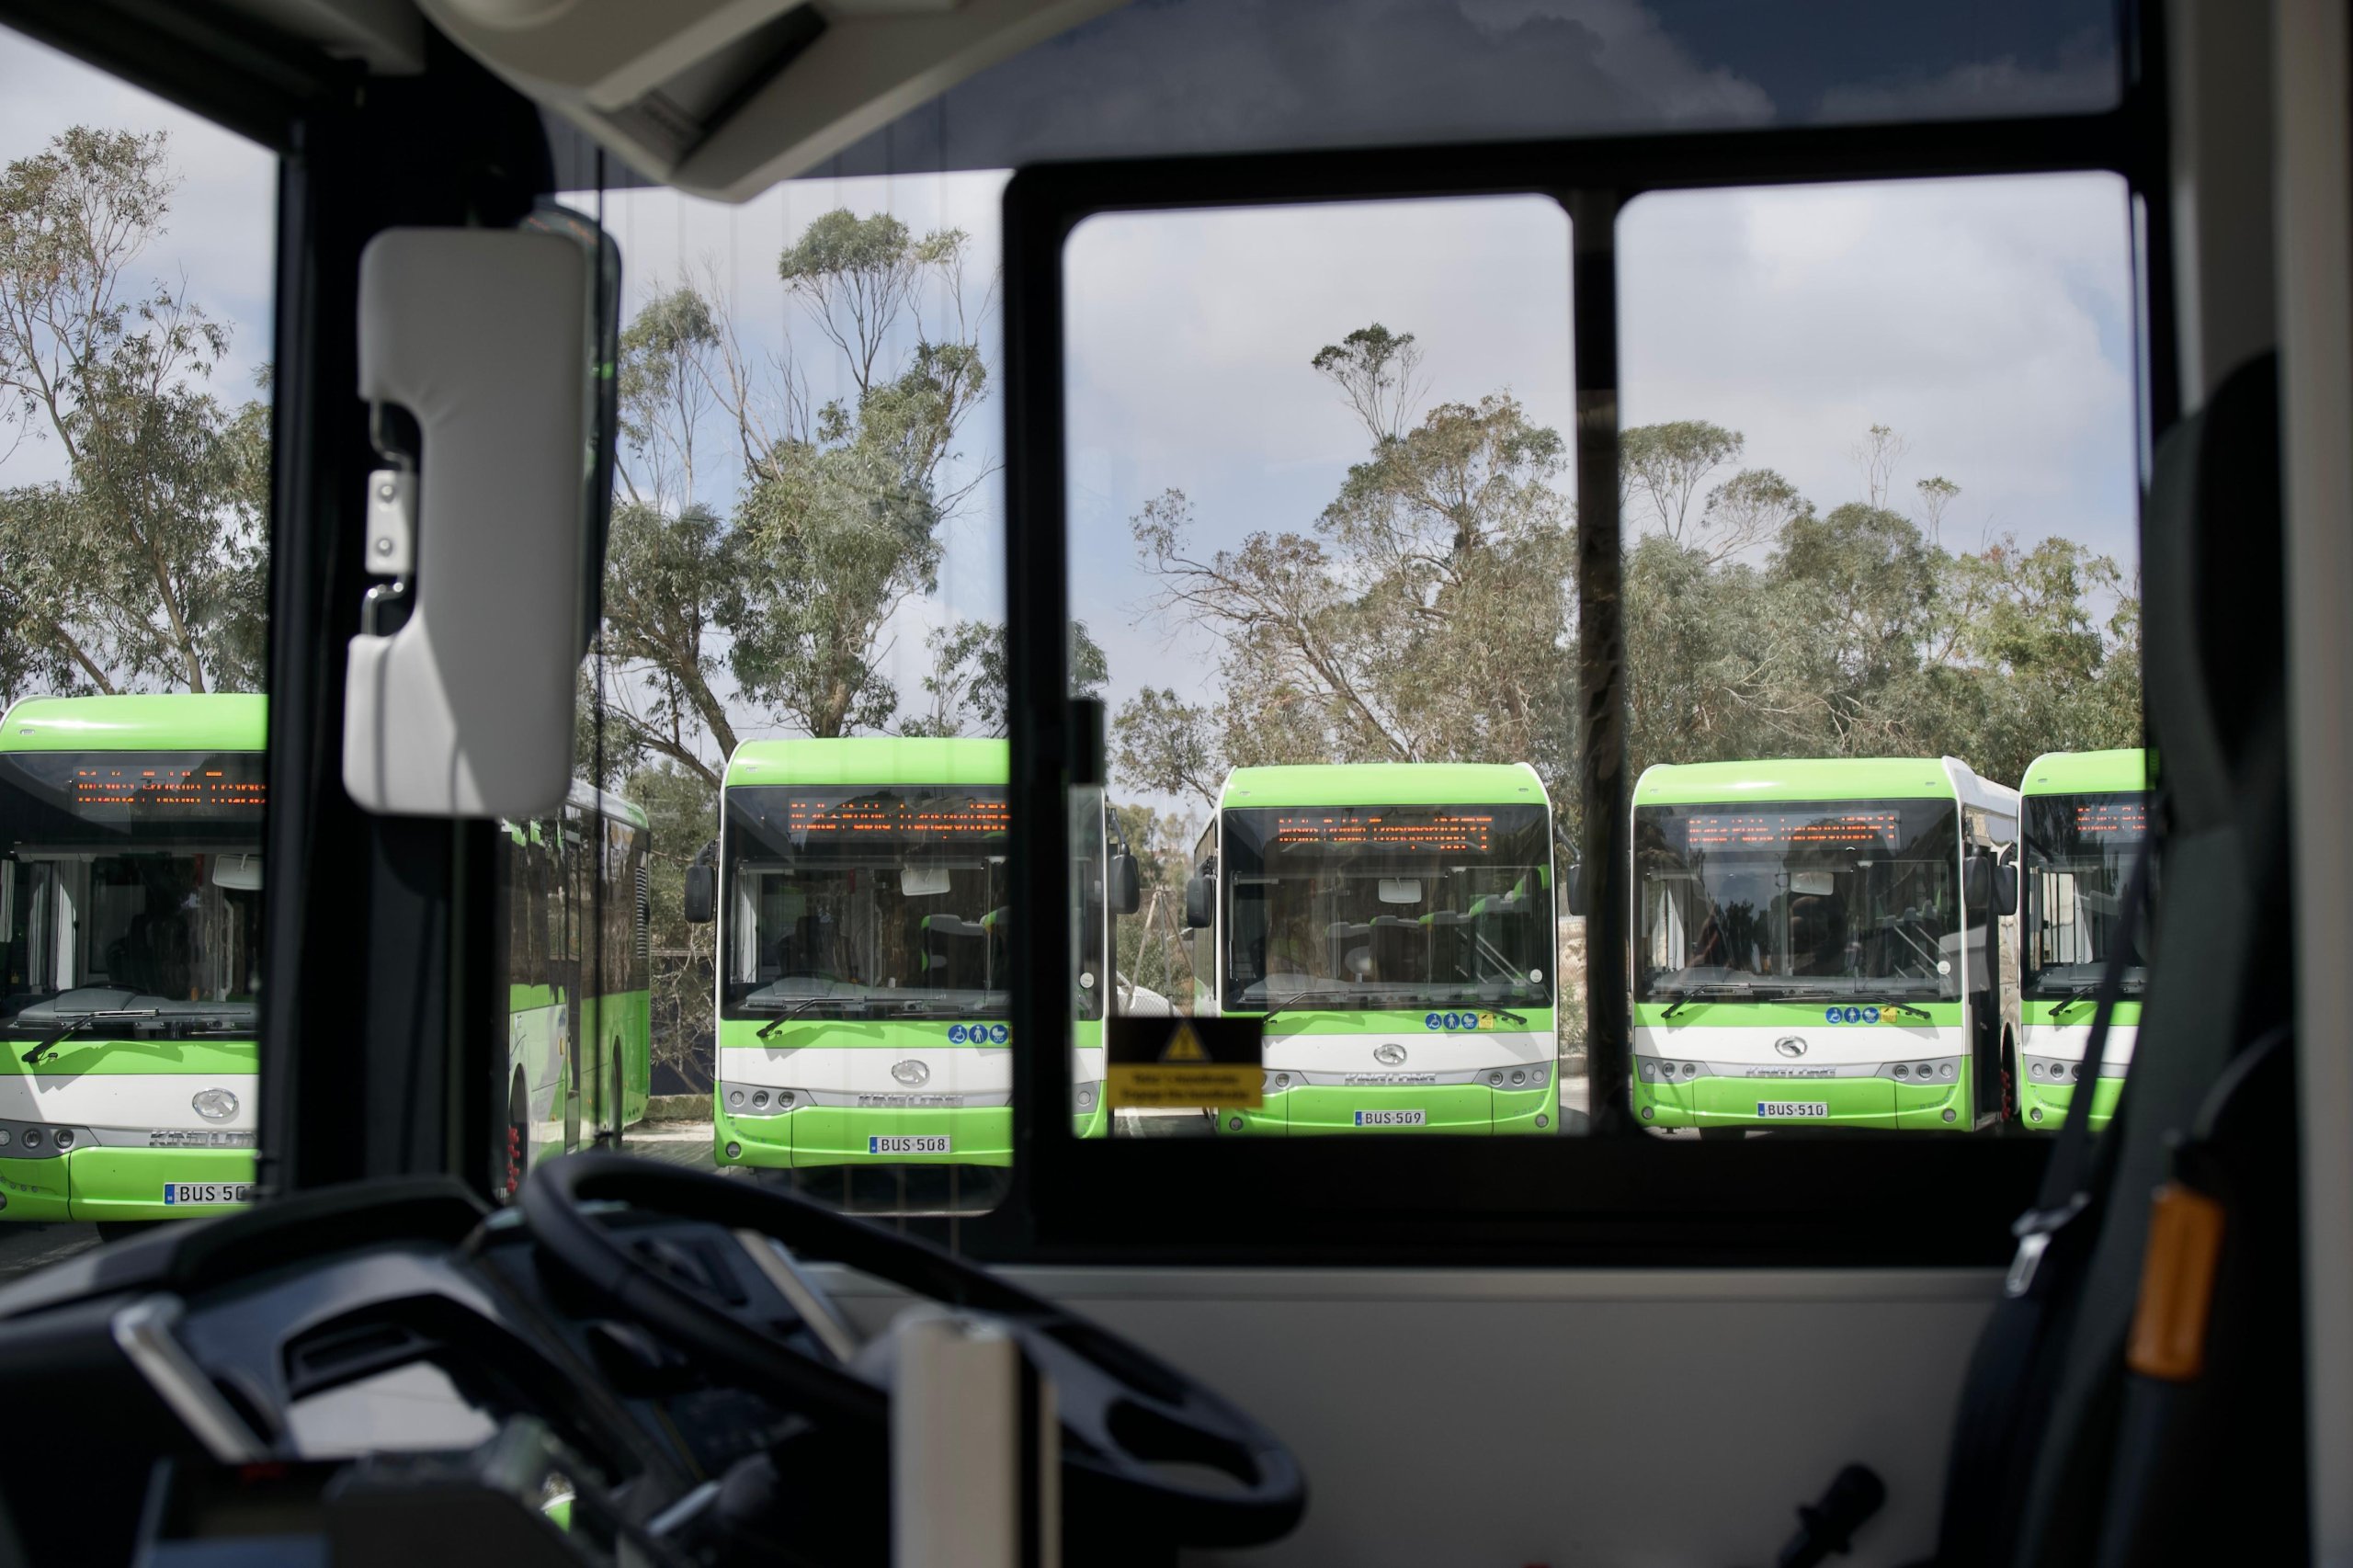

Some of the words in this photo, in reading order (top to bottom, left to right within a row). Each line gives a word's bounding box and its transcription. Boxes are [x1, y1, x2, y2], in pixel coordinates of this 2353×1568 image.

[1768, 1104, 1794, 1116] BUS
[1798, 1104, 1824, 1116] 510
[1365, 1112, 1392, 1124] BUS
[1396, 1112, 1422, 1124] 509
[881, 1138, 911, 1152] BUS
[916, 1138, 946, 1152] 508
[179, 1186, 216, 1201] BUS
